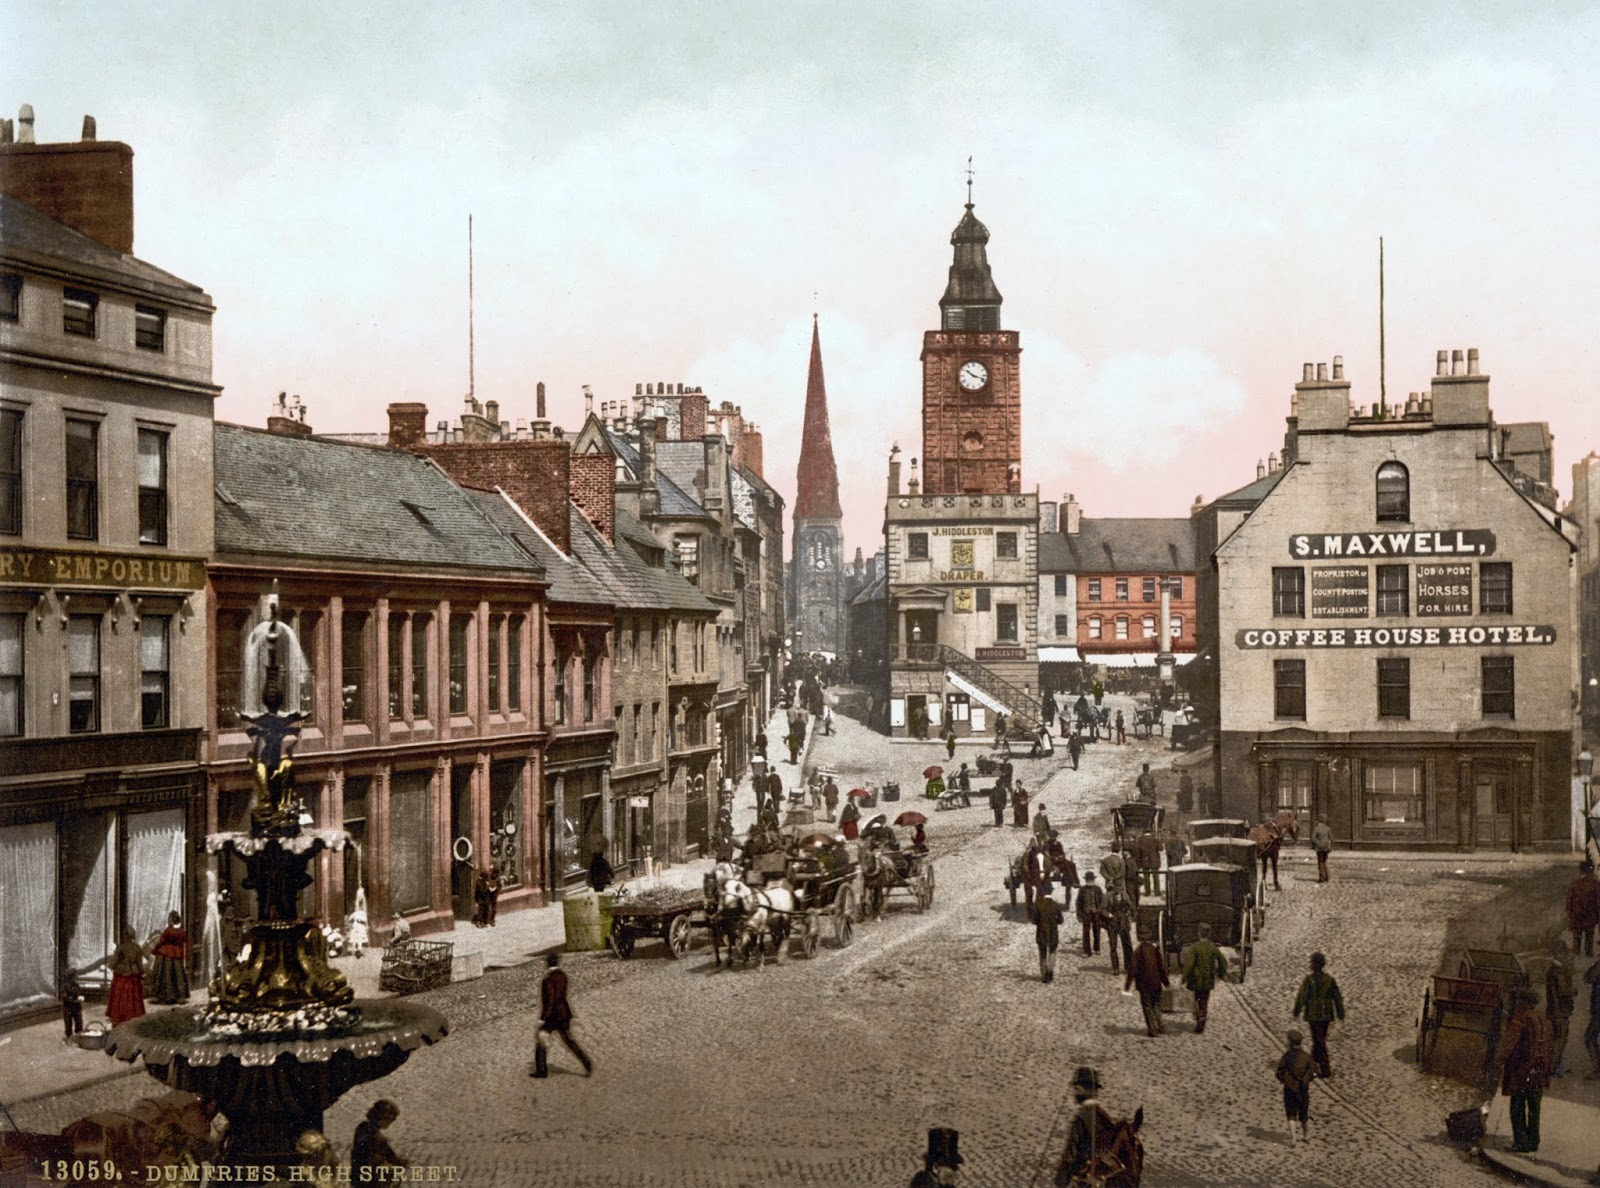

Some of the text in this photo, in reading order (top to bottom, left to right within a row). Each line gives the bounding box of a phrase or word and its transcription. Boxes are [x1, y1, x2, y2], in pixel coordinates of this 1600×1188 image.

[55, 555, 191, 583] EMPORIUM
[1313, 570, 1360, 578] PROPRIETOR
[1447, 566, 1471, 575] POST
[1419, 584, 1469, 597] HORSES
[1418, 605, 1441, 613] FOR
[1244, 626, 1552, 646] COFFEE HOUSE HOTEL.
